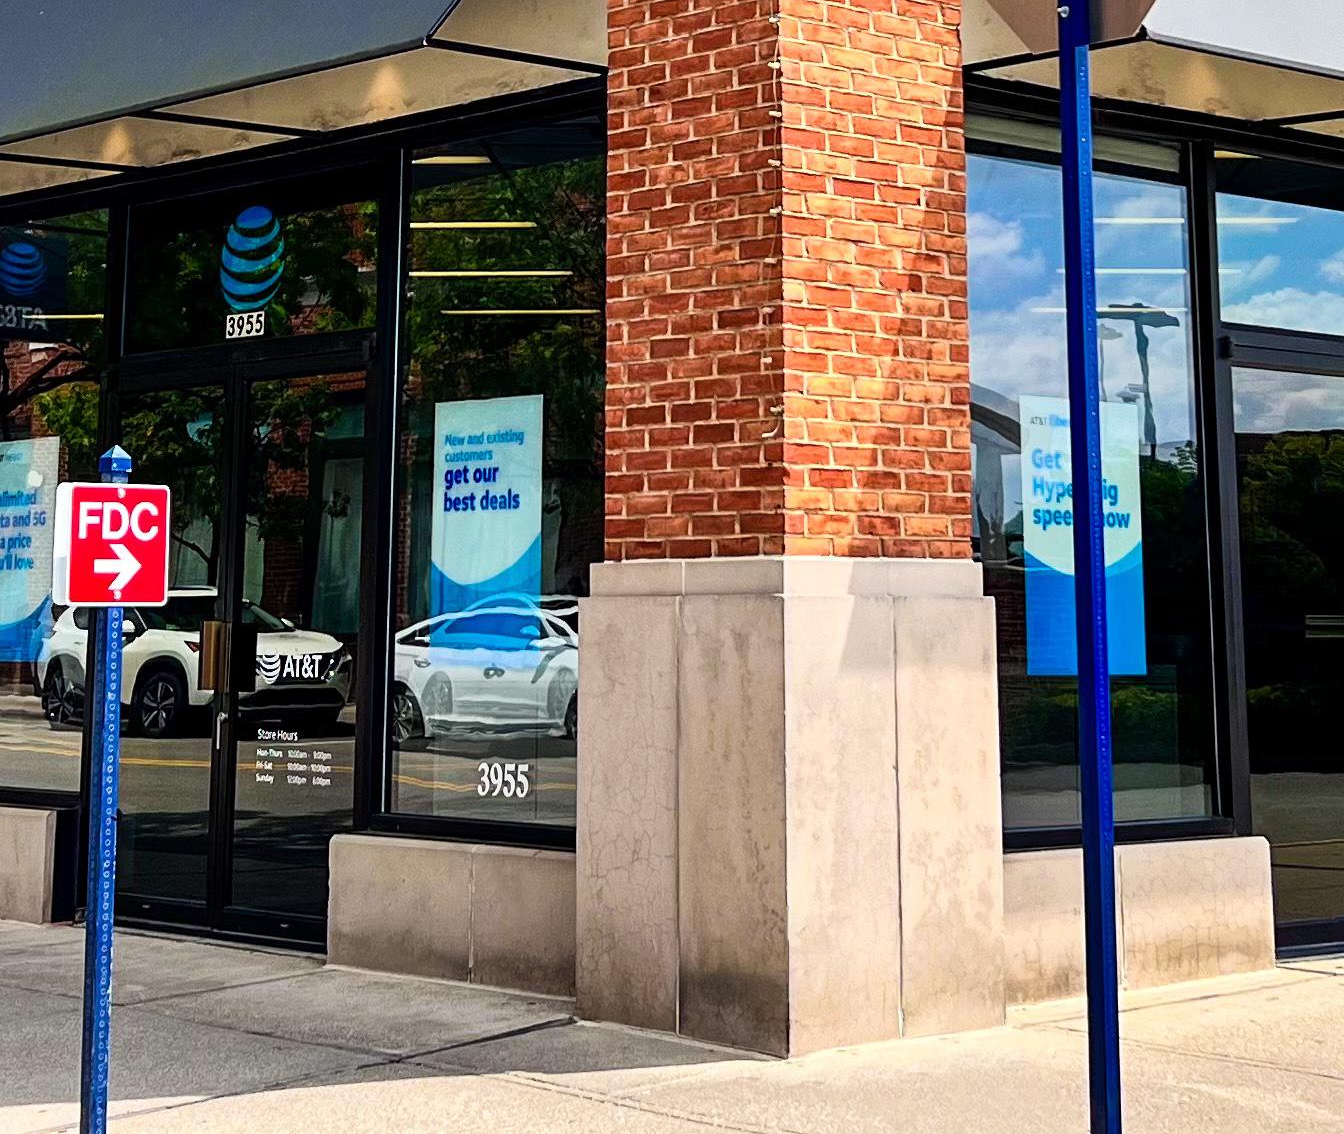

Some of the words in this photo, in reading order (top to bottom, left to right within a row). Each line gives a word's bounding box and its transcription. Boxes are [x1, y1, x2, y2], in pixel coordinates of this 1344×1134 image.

[227, 314, 263, 336] 3955
[445, 434, 465, 446] New
[467, 431, 484, 445] and
[487, 429, 524, 445] existing
[445, 450, 493, 462] customers
[1031, 448, 1062, 469] Get
[444, 466, 469, 490] get
[473, 467, 499, 483] our
[444, 492, 476, 512] best
[480, 488, 520, 510] deals
[12, 511, 31, 526] and
[33, 511, 46, 526] 5G
[78, 501, 159, 541] FDC
[0, 537, 5, 549] a
[8, 533, 32, 553] price
[15, 553, 34, 569] love
[283, 654, 322, 678] AT&T
[258, 728, 276, 740] Store
[277, 730, 298, 741] Hours
[477, 762, 529, 798] 3955
